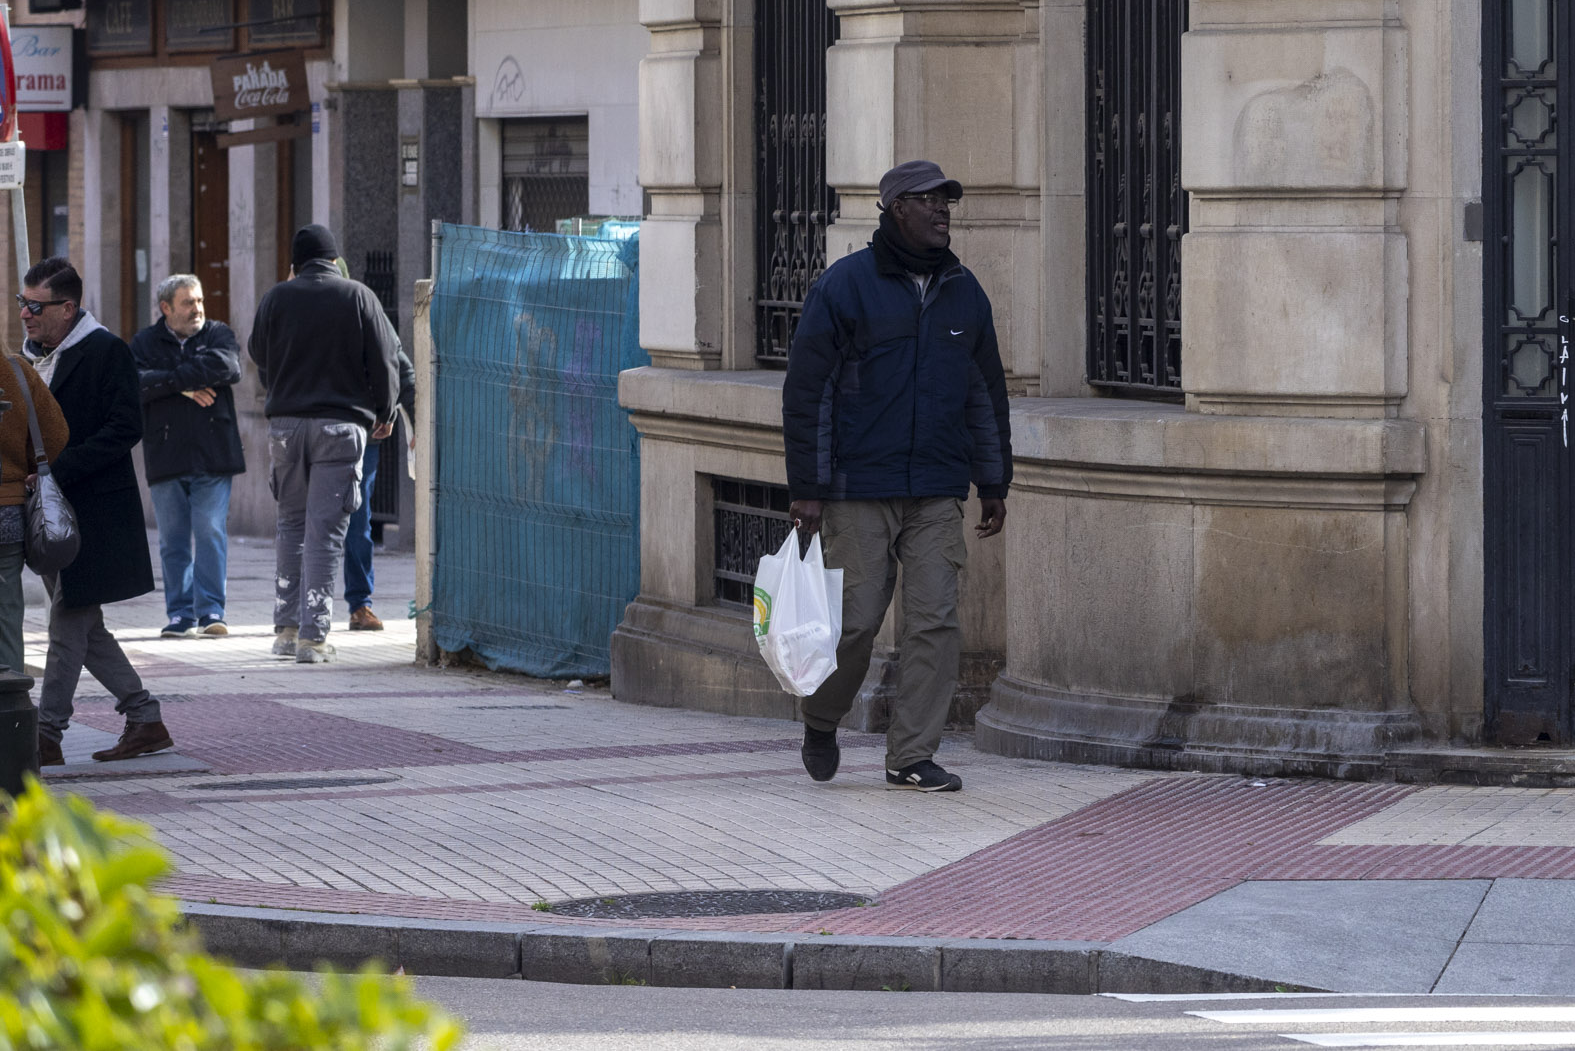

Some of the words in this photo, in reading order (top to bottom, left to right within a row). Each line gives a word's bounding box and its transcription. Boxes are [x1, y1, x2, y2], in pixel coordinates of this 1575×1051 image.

[11, 34, 61, 58] Bar
[16, 72, 67, 91] rama
[233, 69, 289, 91] PARADA
